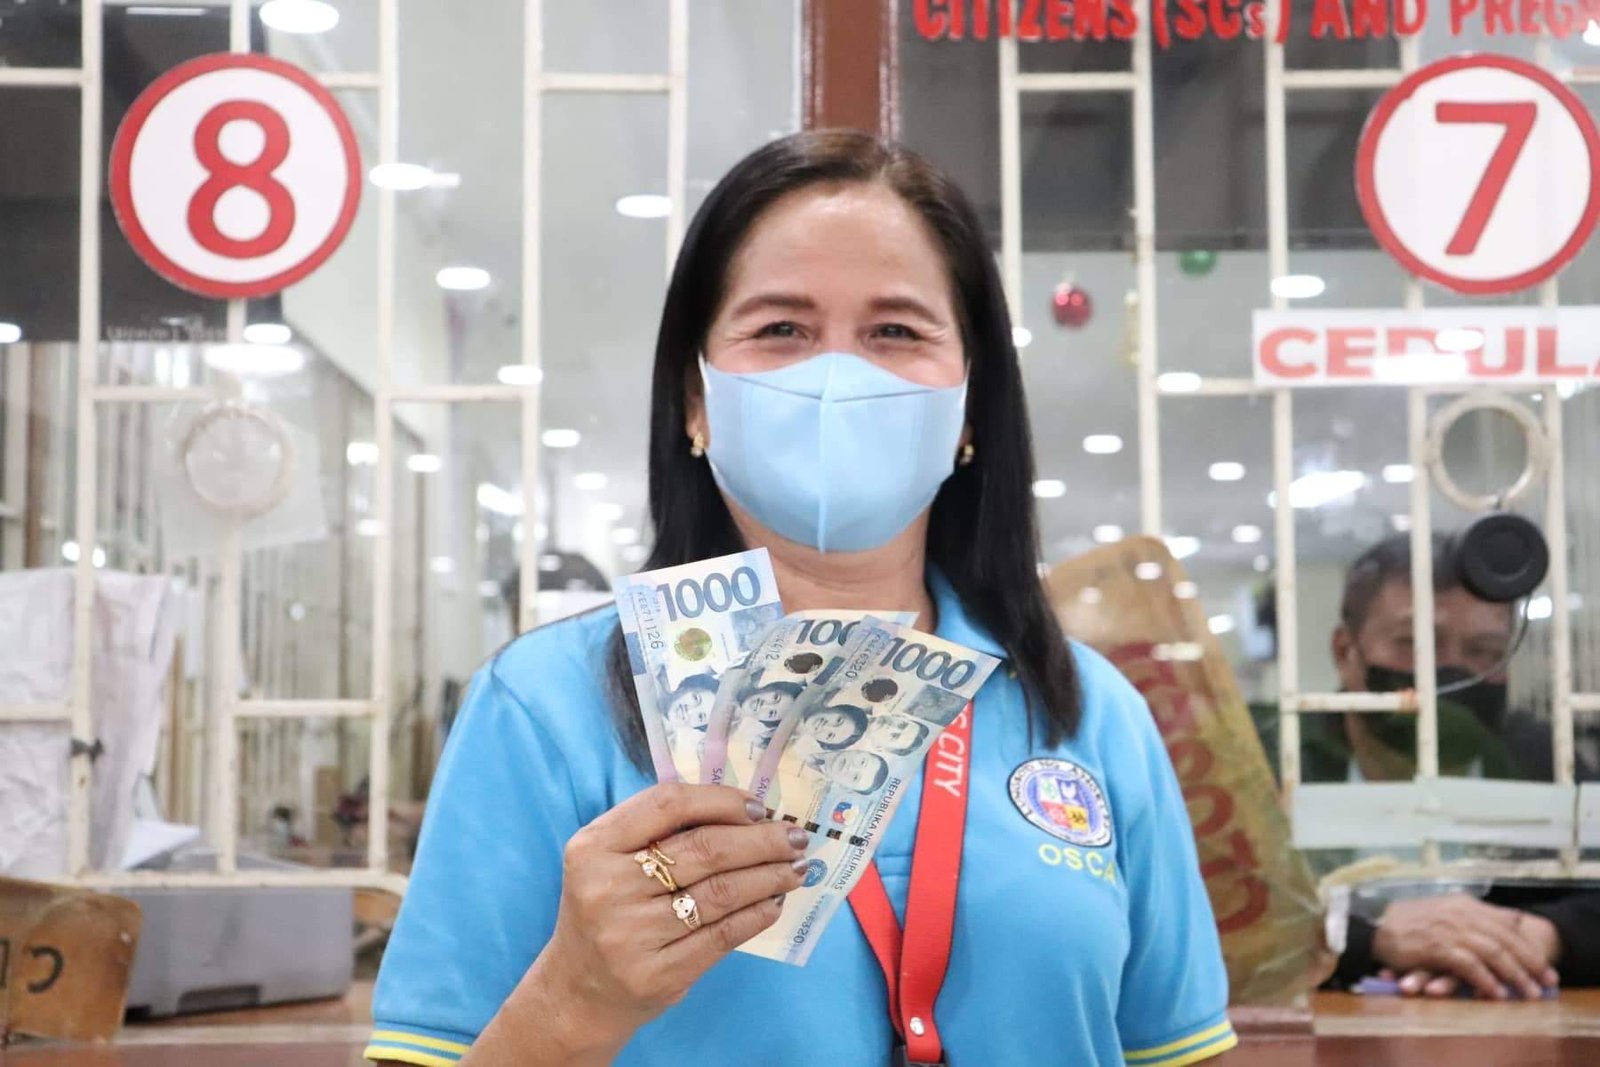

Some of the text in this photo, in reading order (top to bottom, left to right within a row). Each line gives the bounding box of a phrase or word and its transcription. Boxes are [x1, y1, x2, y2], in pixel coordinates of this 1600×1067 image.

[1309, 0, 1427, 41] AND
[1449, 0, 1600, 40] PREG
[187, 99, 296, 259] 8
[1435, 102, 1538, 256] 7
[1259, 327, 1600, 378] CEUL
[656, 566, 761, 622] 1000
[879, 636, 977, 690] 1000
[933, 731, 966, 798] CITY
[869, 777, 901, 830] REPUBLIKA
[834, 846, 866, 891] PILIPINAS
[1038, 843, 1118, 888] OSCA
